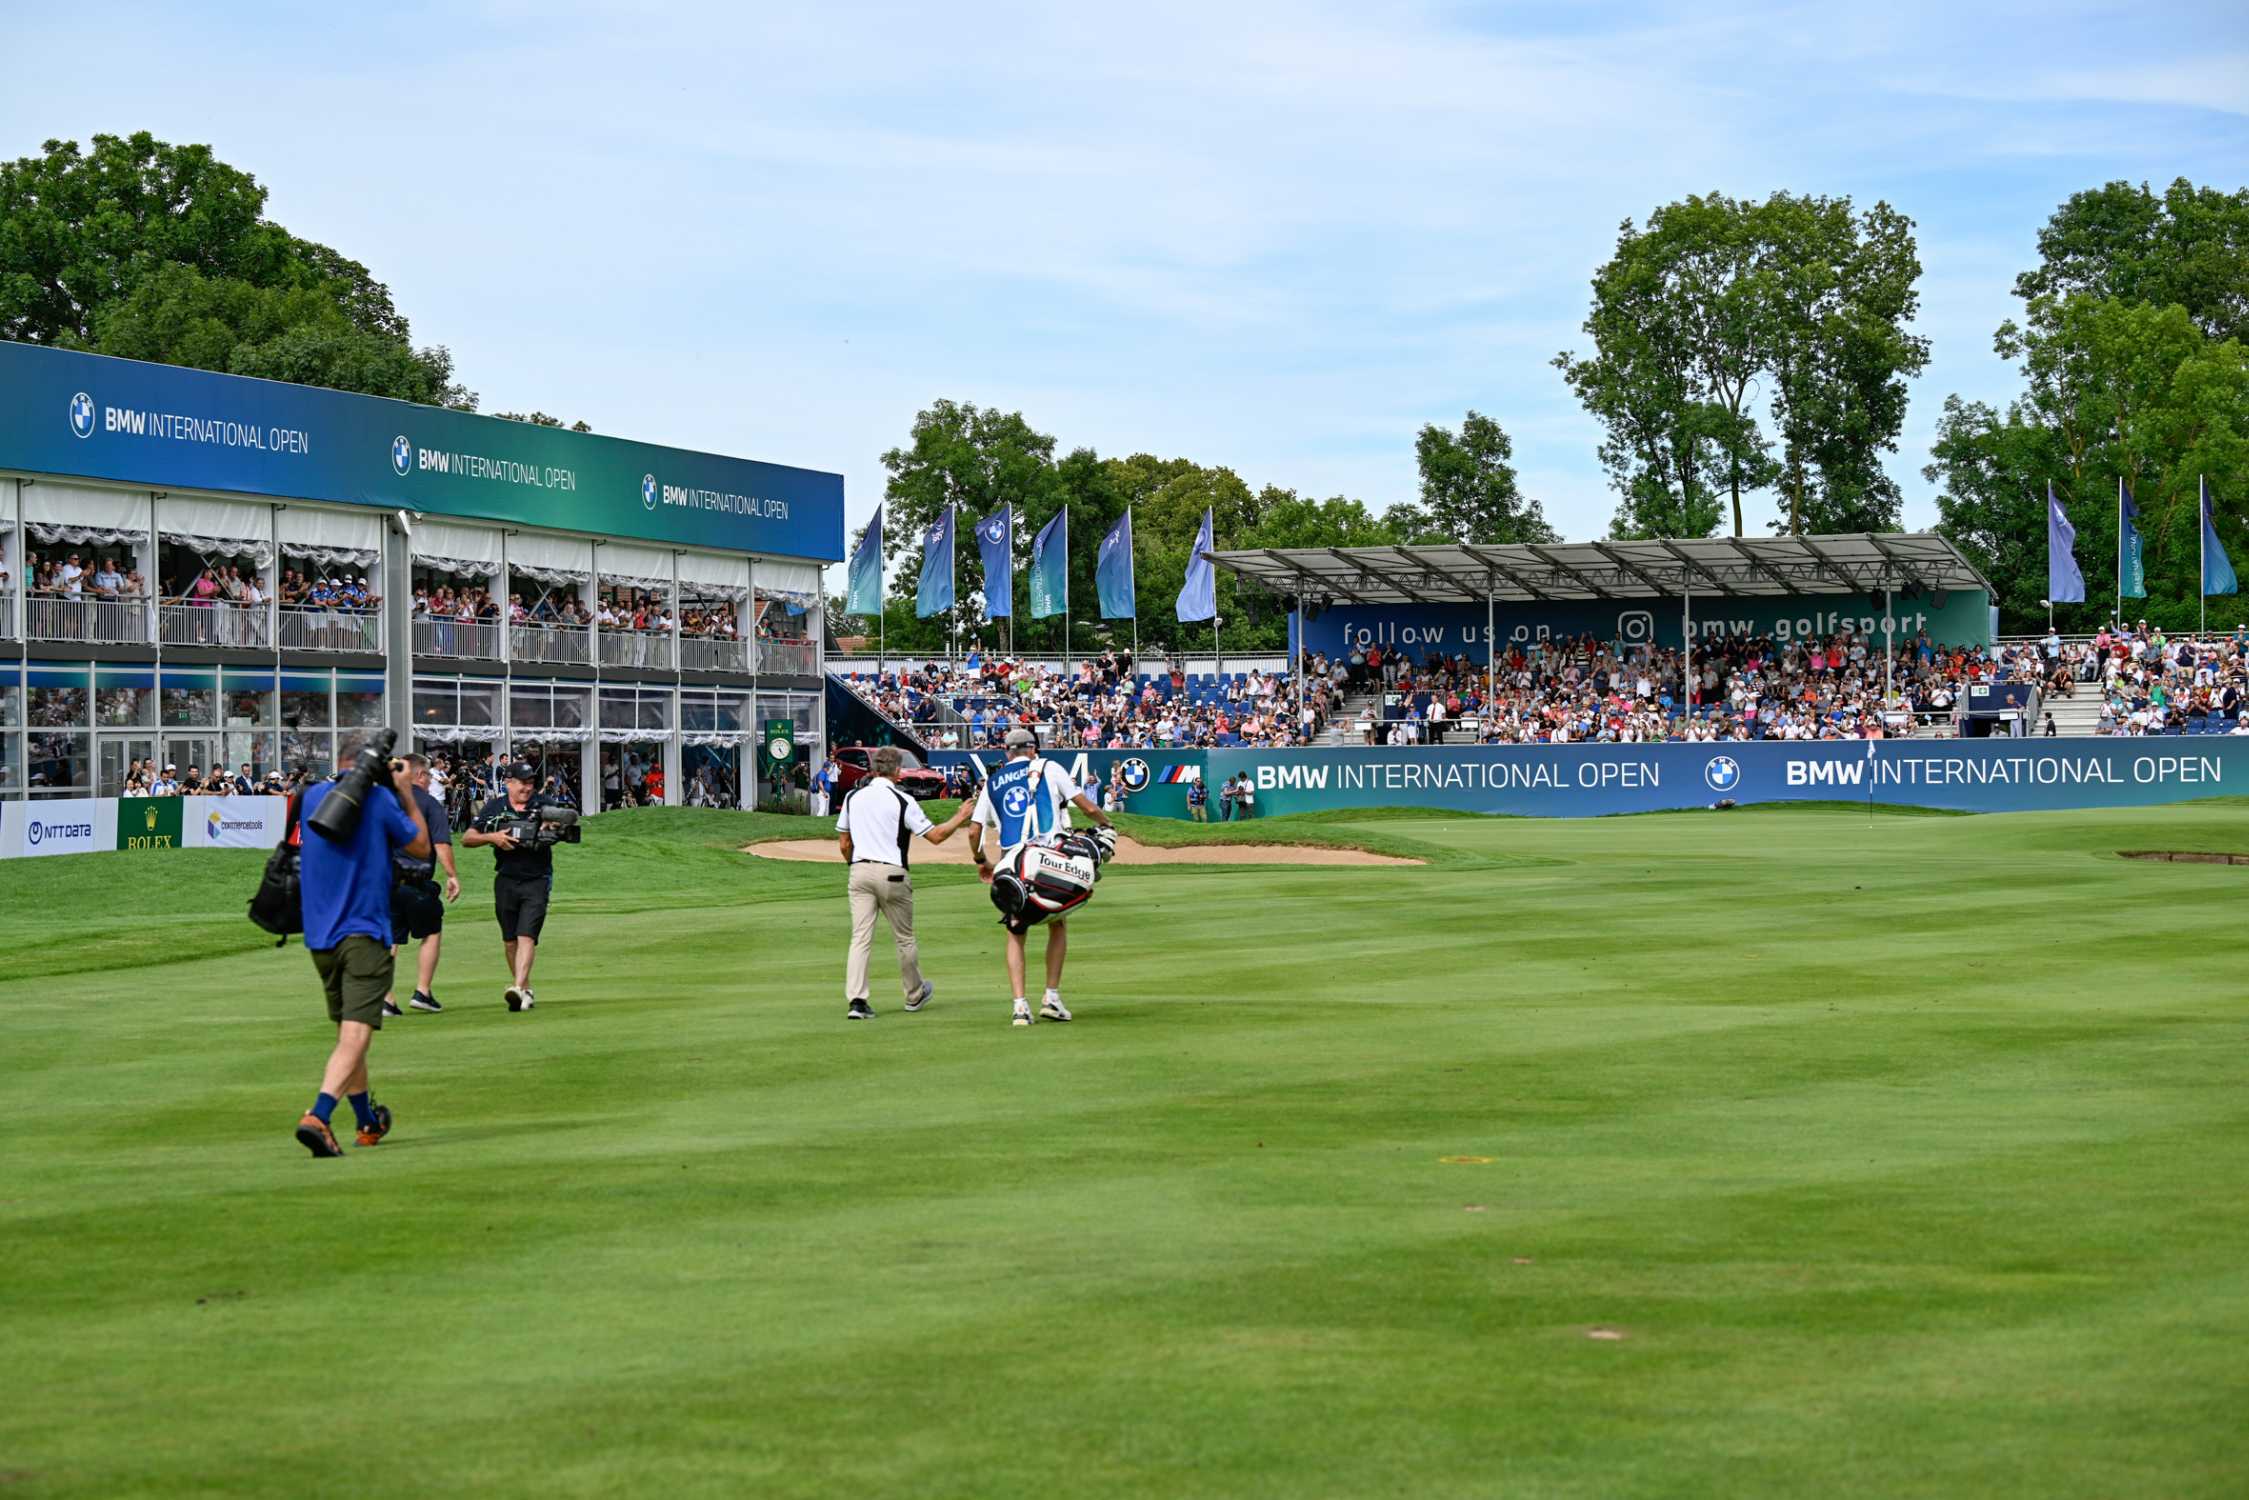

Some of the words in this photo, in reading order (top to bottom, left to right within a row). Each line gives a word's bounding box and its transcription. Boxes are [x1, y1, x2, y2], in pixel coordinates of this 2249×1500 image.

[106, 407, 145, 435] BMW
[149, 412, 267, 450] INTERNATIONAL
[269, 427, 308, 454] OPEN
[418, 448, 449, 473] BMW
[451, 454, 543, 487] INTERNATIONAL
[545, 467, 576, 491] OPEN
[663, 484, 687, 507] BMW
[689, 489, 762, 516] INTERNATIONAL
[764, 499, 789, 520] OPEN
[1344, 622, 1444, 645] follow
[1463, 625, 1496, 643] us
[1514, 624, 1551, 642] on
[992, 766, 1029, 791] LANGE
[1257, 764, 1328, 790] BMW
[1337, 763, 1570, 789] INTERNATIONAL
[1578, 762, 1660, 788] OPEN
[1786, 760, 1865, 786] BMW
[1873, 757, 2125, 786] INTERNATIONAL
[2133, 756, 2222, 783] OPEN
[45, 825, 64, 839] NTT
[128, 834, 172, 850] ROLEX
[1038, 852, 1063, 869] Tour
[1065, 862, 1091, 881] Edge
